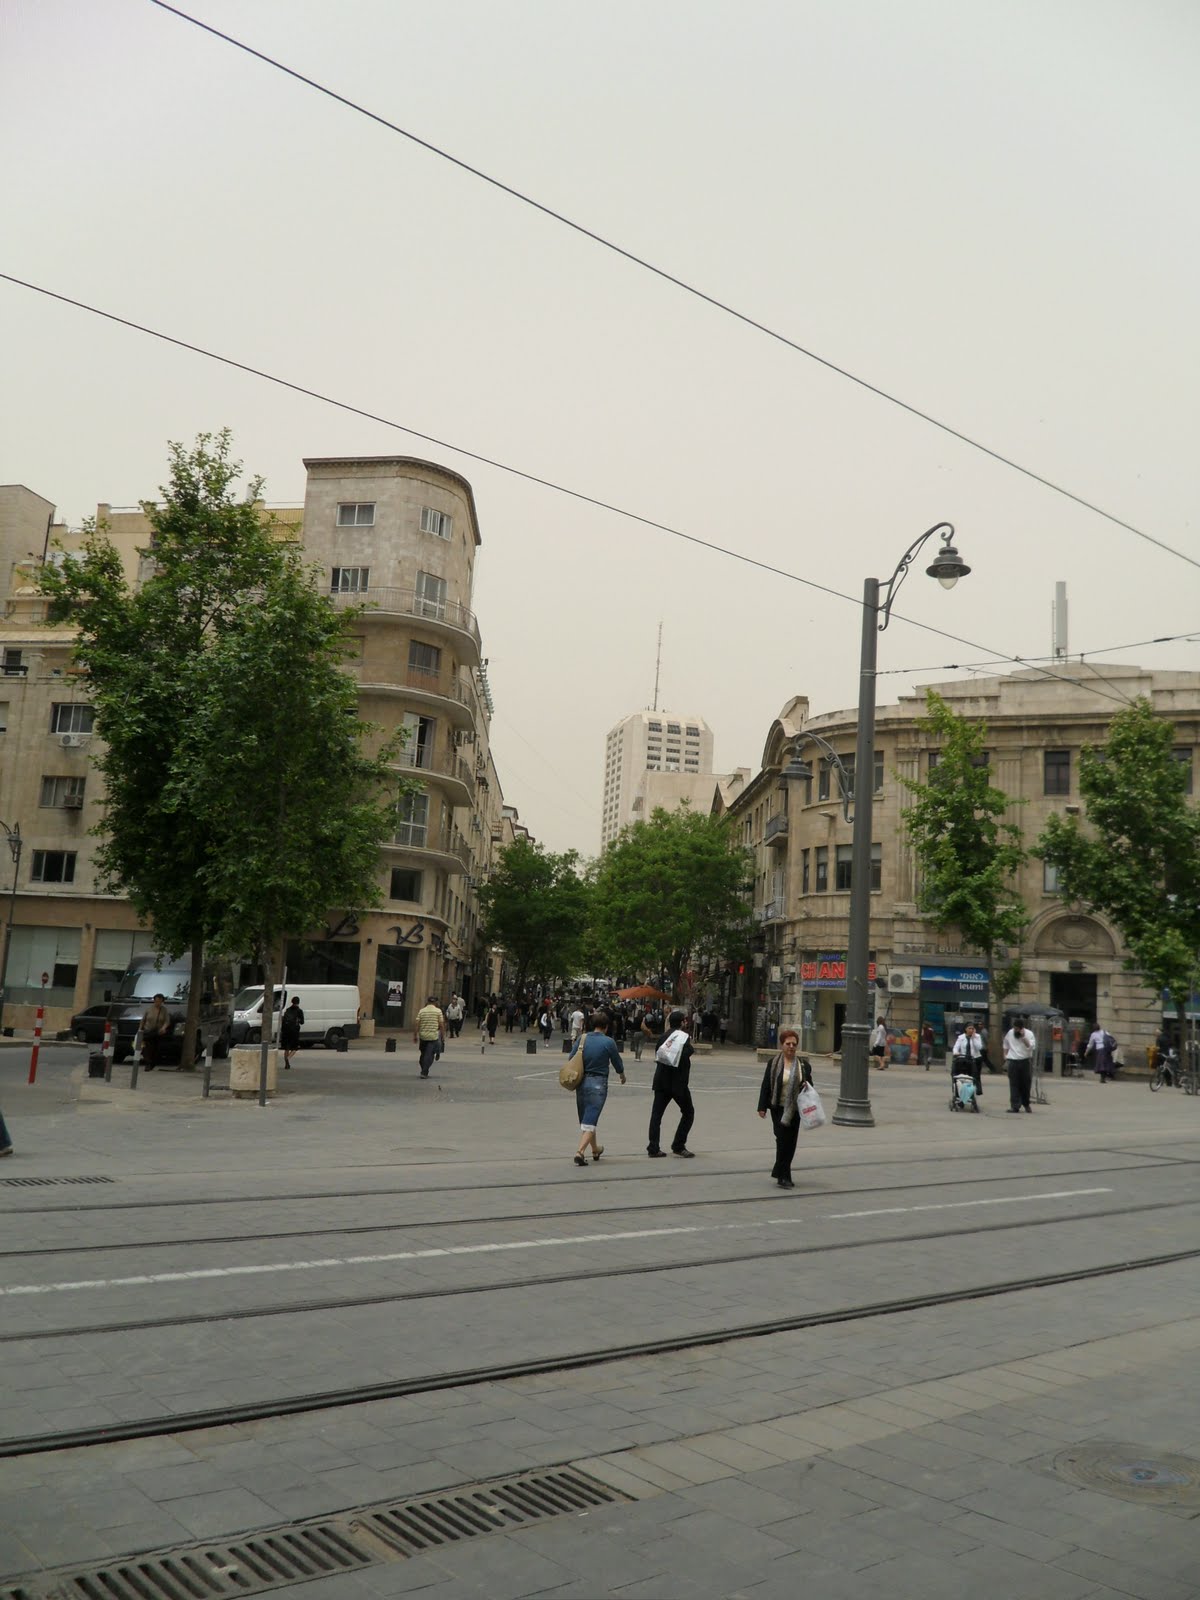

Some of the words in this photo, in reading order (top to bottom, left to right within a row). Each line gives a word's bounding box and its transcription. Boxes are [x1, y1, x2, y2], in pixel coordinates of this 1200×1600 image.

[801, 961, 877, 981] CHANE
[960, 972, 983, 980] לאומי
[959, 982, 984, 991] leumi
